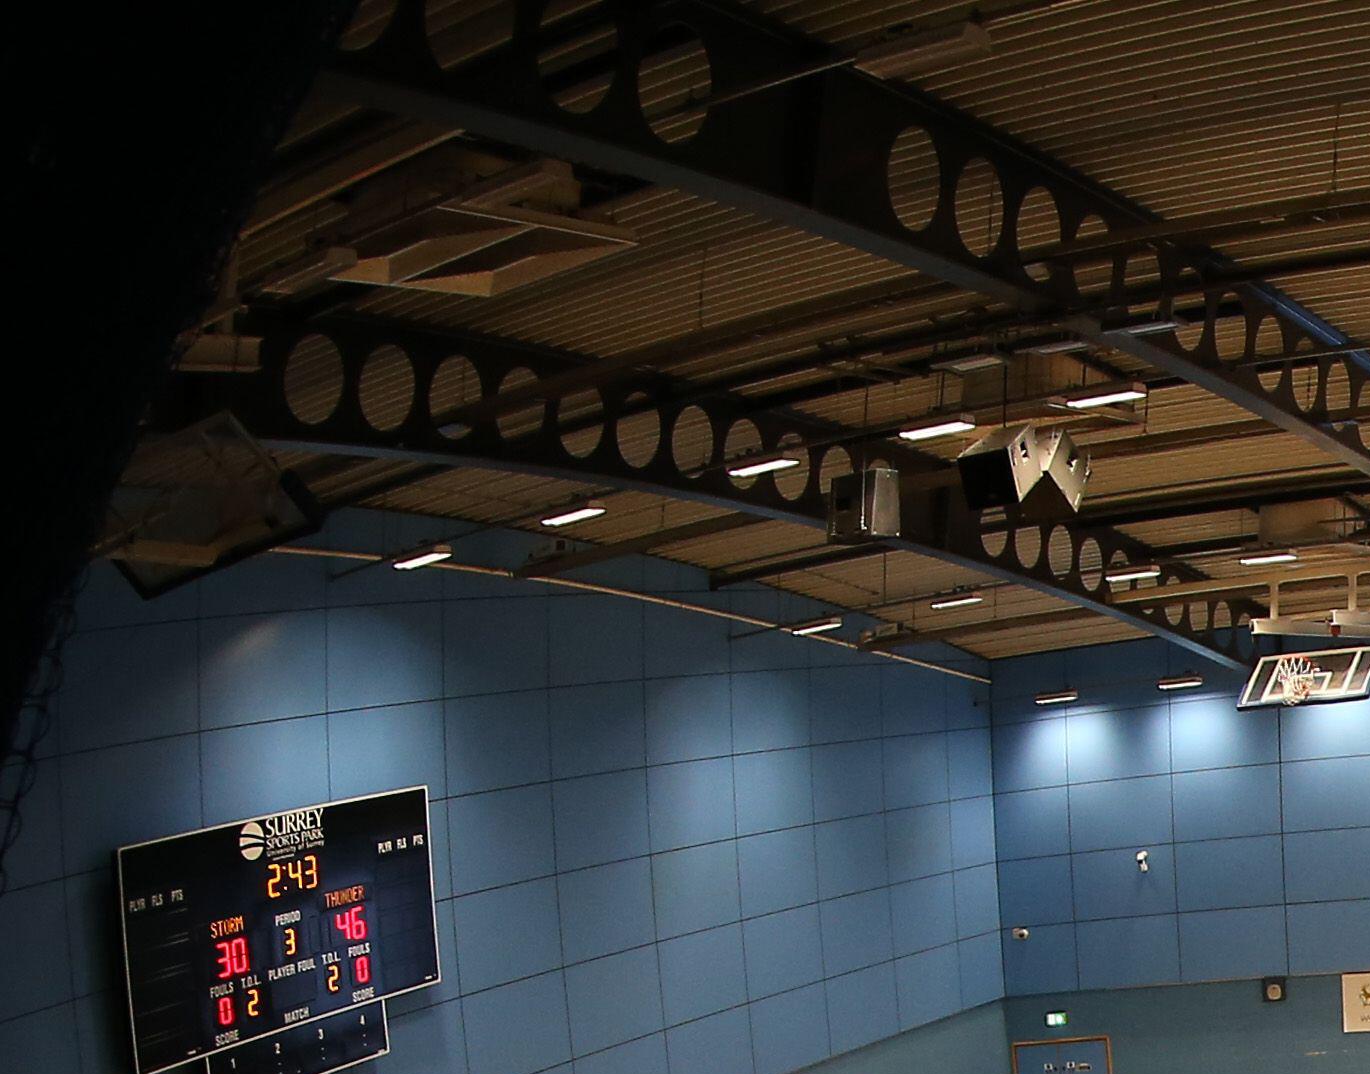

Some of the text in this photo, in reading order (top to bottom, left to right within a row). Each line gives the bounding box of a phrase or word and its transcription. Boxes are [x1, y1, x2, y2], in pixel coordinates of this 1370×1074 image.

[265, 808, 324, 838] SURREY
[266, 828, 325, 850] SPORTS PARK
[413, 834, 424, 847] PTS
[267, 854, 318, 899] 2:43
[129, 888, 184, 912] PLYR FLS PTS
[324, 884, 366, 910] THUNDER
[210, 915, 244, 939] STORM
[275, 910, 301, 927] PERIOD
[335, 905, 368, 941] 46
[215, 937, 249, 980] 30
[284, 928, 296, 956] 3
[208, 982, 234, 998] FOULS
[268, 963, 296, 981] PLAYER
[297, 957, 317, 973] FOUL
[348, 943, 370, 958] FOULS
[327, 955, 370, 993] 2 0
[215, 986, 375, 1046] SCORE MATCH SCORE
[219, 989, 259, 1026] 0 2
[275, 1043, 280, 1054] 2
[318, 1028, 324, 1040] 3
[360, 1014, 366, 1026] 4
